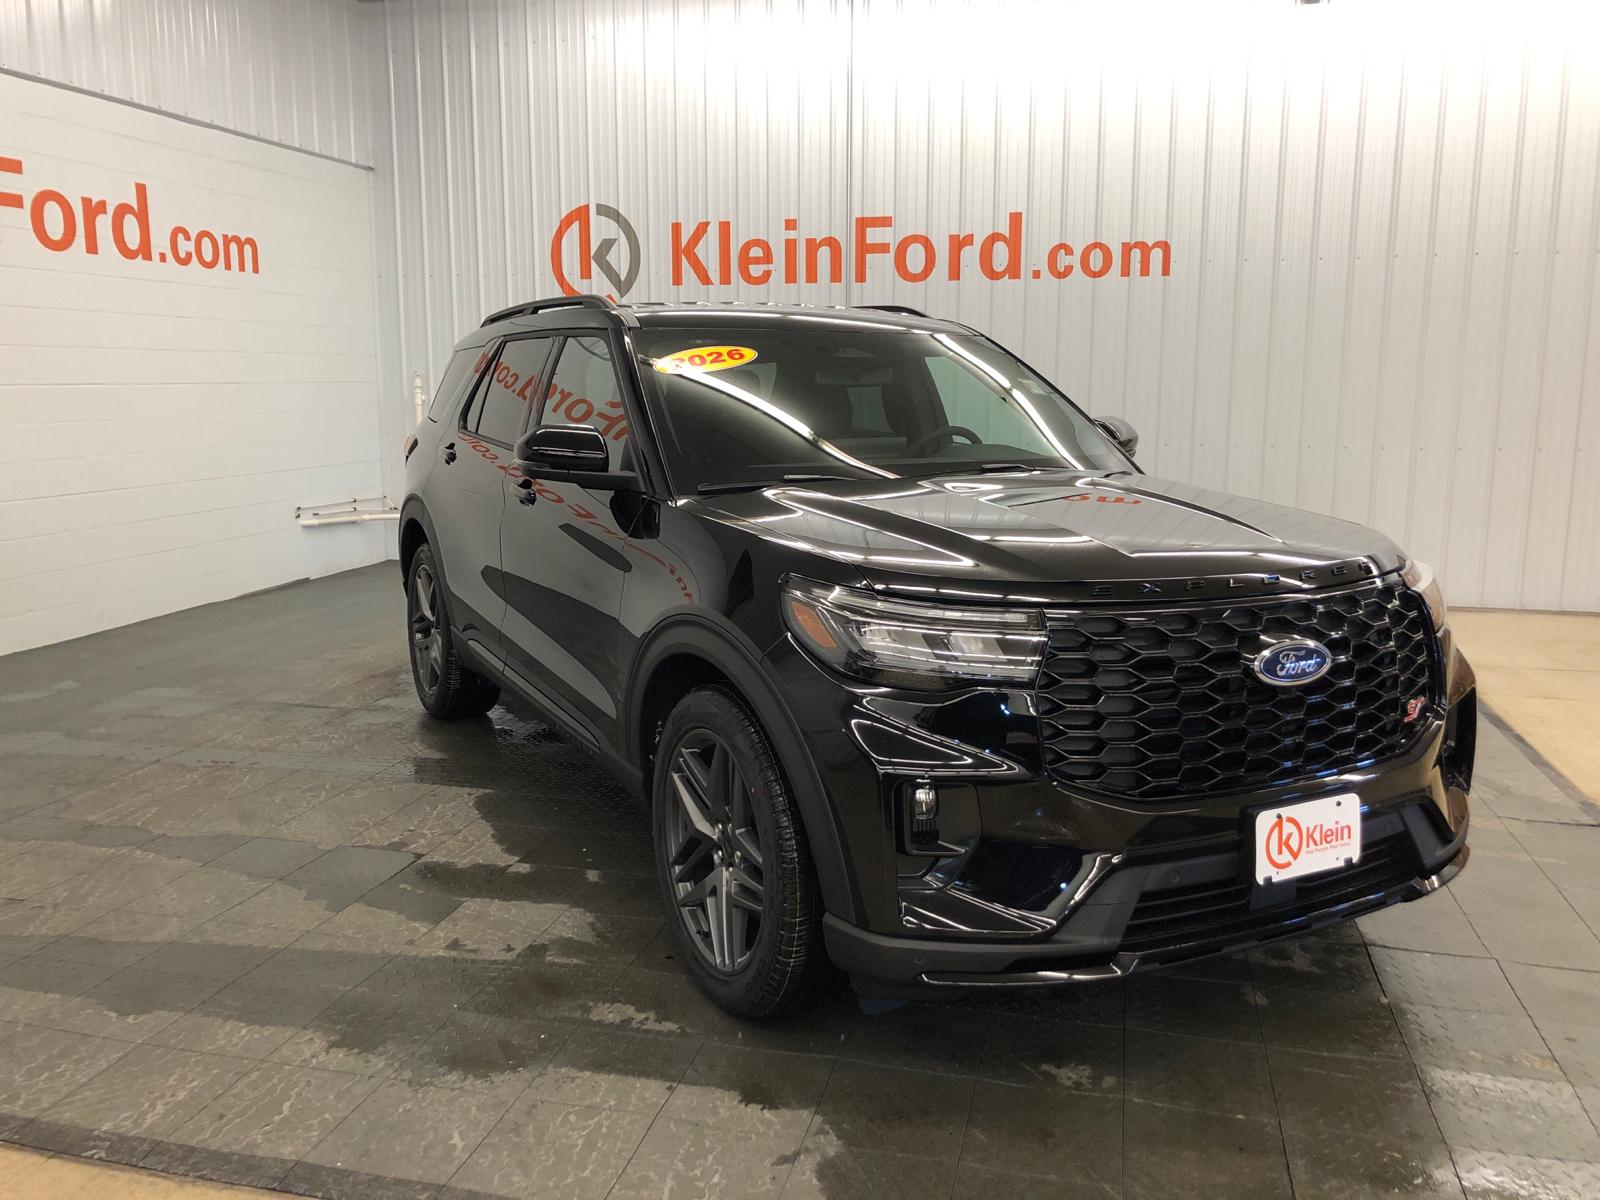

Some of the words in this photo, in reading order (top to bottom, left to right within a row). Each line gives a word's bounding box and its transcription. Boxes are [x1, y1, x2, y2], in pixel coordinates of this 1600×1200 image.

[671, 212, 1171, 286] KleinFord.com
[1091, 560, 1376, 596] EXPLORER
[1276, 650, 1321, 676] Ford
[1404, 697, 1425, 722] ST
[1306, 821, 1351, 849] Klein
